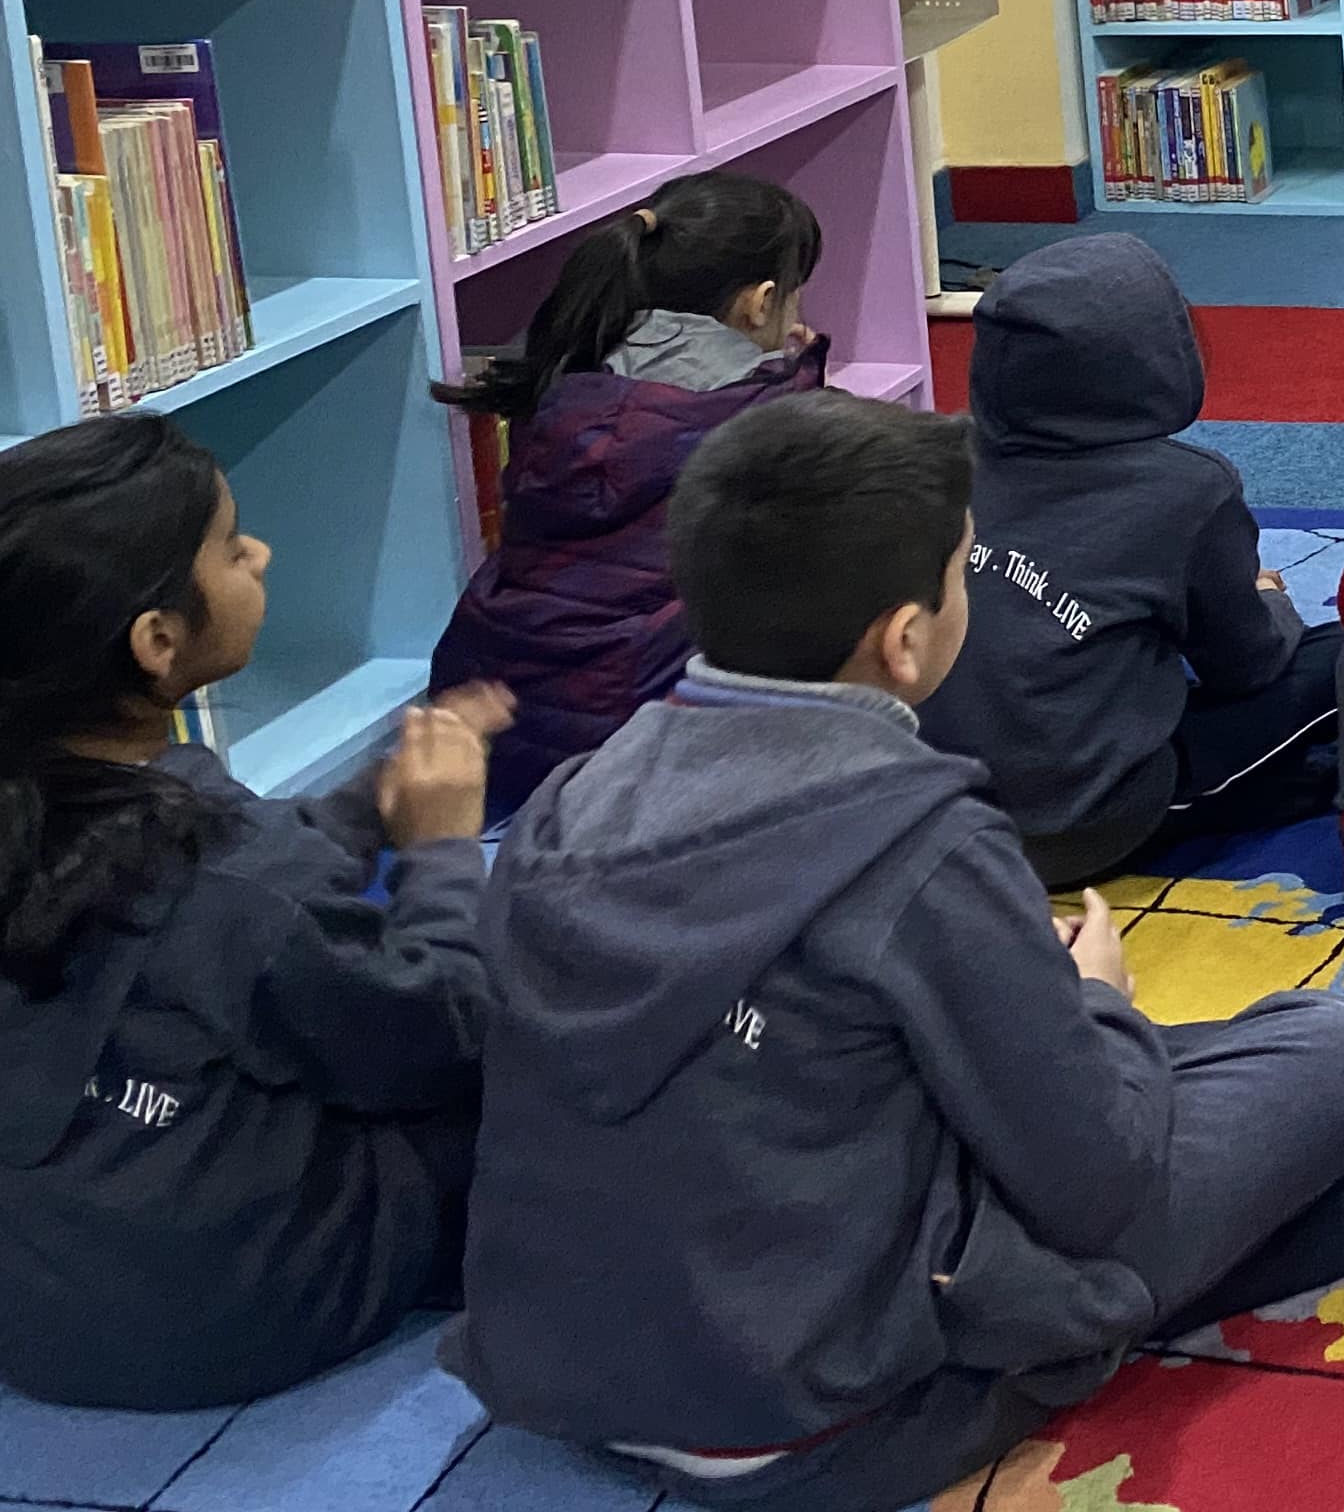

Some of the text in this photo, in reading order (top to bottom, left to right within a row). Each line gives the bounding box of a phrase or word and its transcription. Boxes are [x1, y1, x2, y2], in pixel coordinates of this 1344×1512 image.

[969, 544, 1092, 641] ay Think LIVE
[117, 1078, 180, 1127] LIVE
